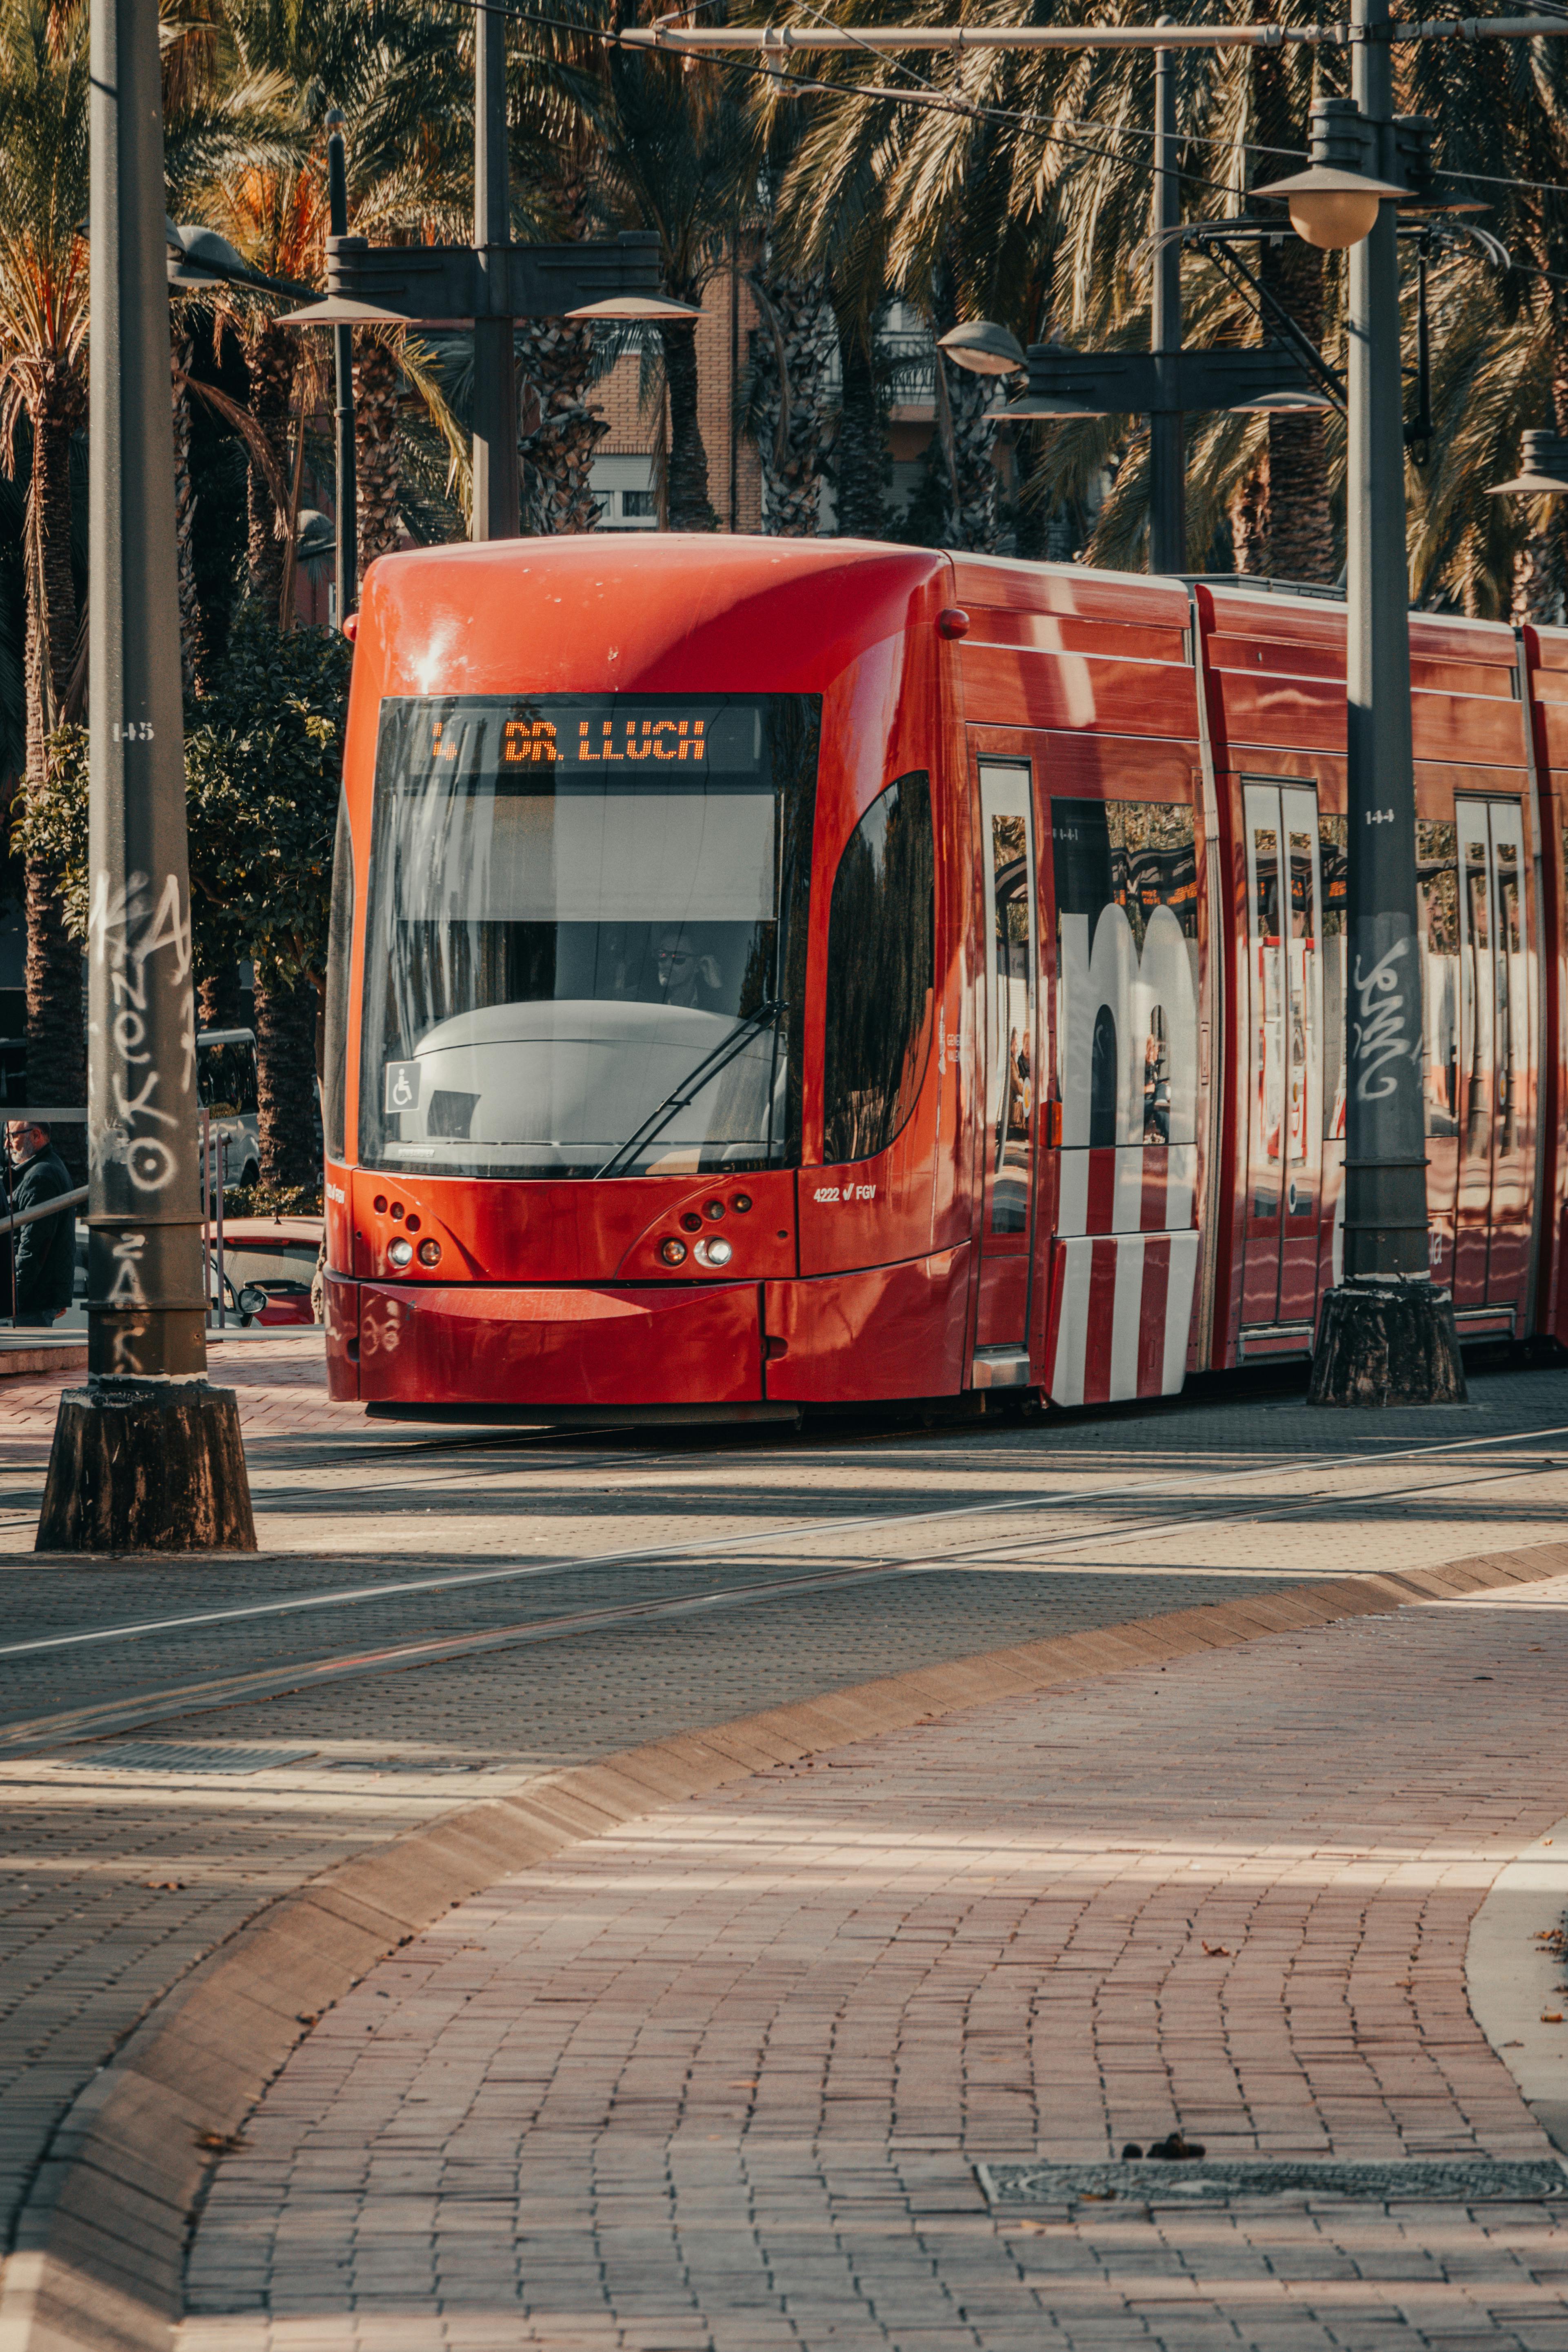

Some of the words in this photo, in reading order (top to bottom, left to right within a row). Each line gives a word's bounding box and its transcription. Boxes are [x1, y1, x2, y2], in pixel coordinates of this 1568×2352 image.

[505, 722, 564, 761] DR.
[579, 721, 705, 760] LLUCH
[813, 1188, 840, 1202] 4222
[856, 1185, 876, 1199] FGV
